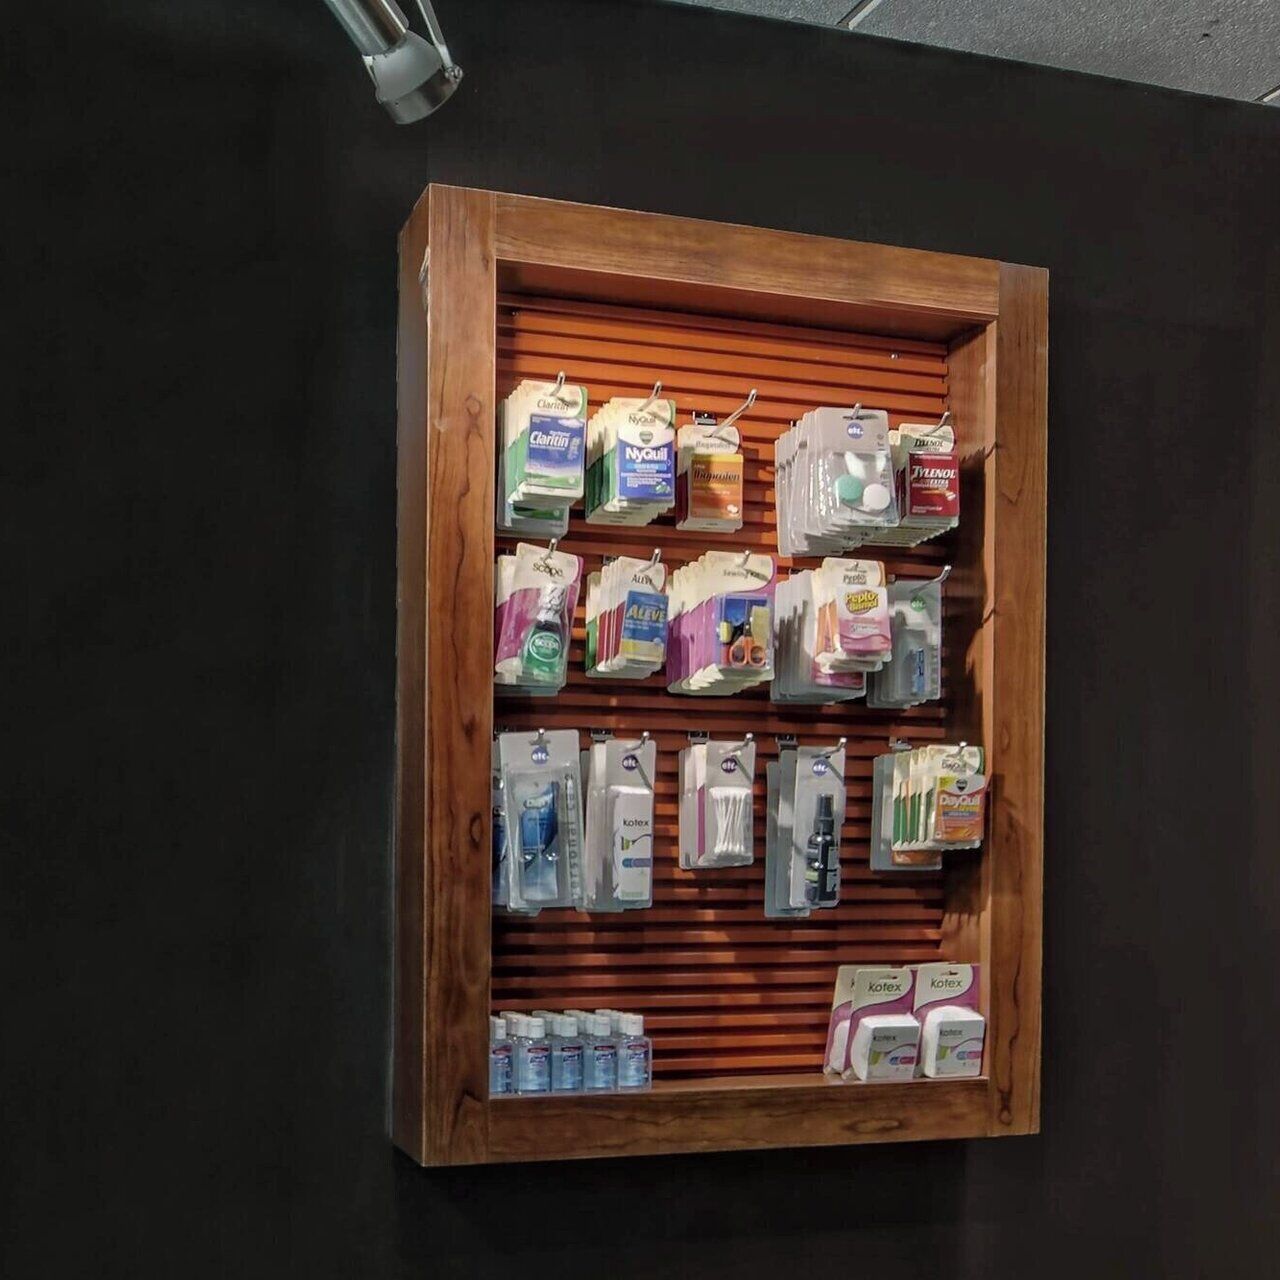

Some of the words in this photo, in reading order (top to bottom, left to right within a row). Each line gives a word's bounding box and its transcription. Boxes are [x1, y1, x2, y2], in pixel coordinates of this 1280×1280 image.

[530, 431, 569, 448] Claritin
[626, 447, 668, 462] NyQuil
[912, 465, 956, 480] TYLENOL
[626, 604, 666, 622] ALEVE
[623, 818, 650, 828] kotex
[868, 981, 902, 993] kotex
[931, 977, 963, 989] kotex
